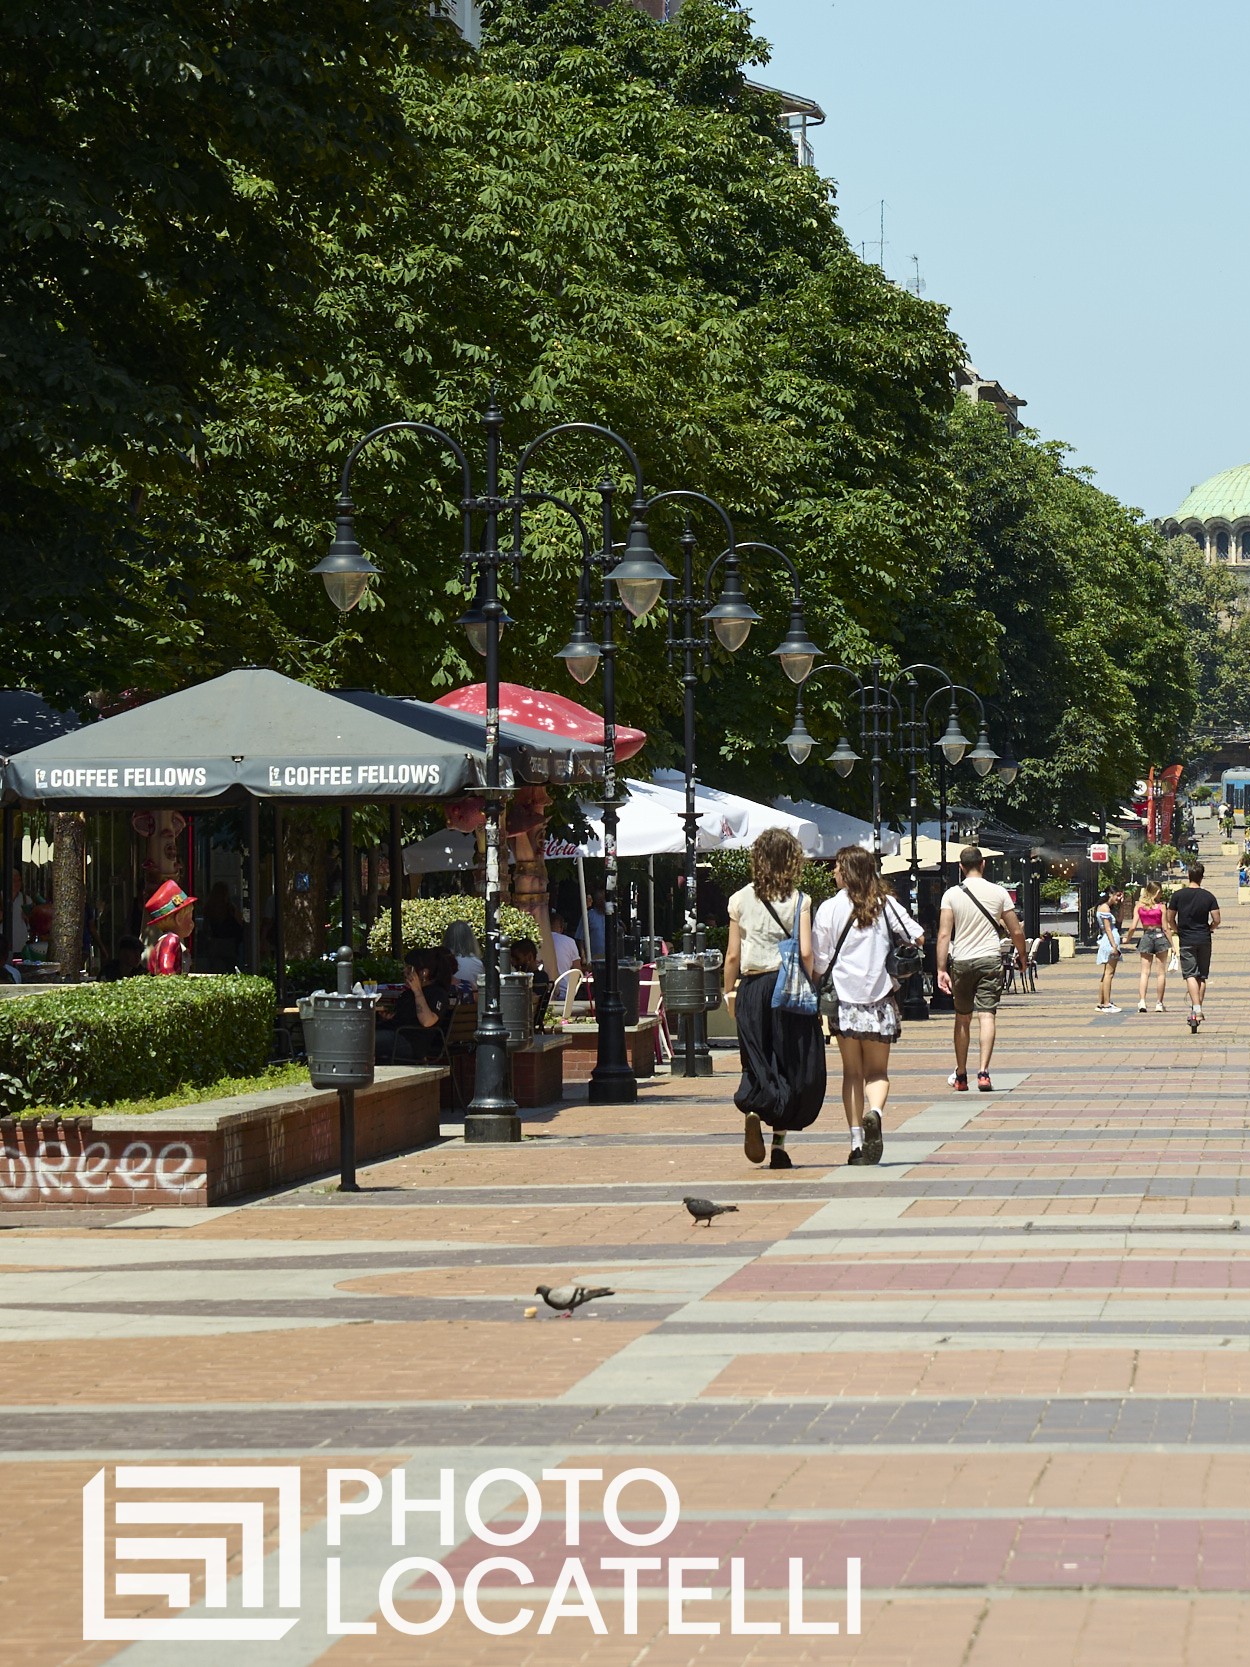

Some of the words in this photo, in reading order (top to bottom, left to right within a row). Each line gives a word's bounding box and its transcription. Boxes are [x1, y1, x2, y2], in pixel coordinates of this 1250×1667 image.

[50, 769, 119, 788] COFFEE
[123, 767, 207, 787] FELLOWS
[284, 766, 352, 786] COFFEE
[357, 764, 440, 785] FELLOWS
